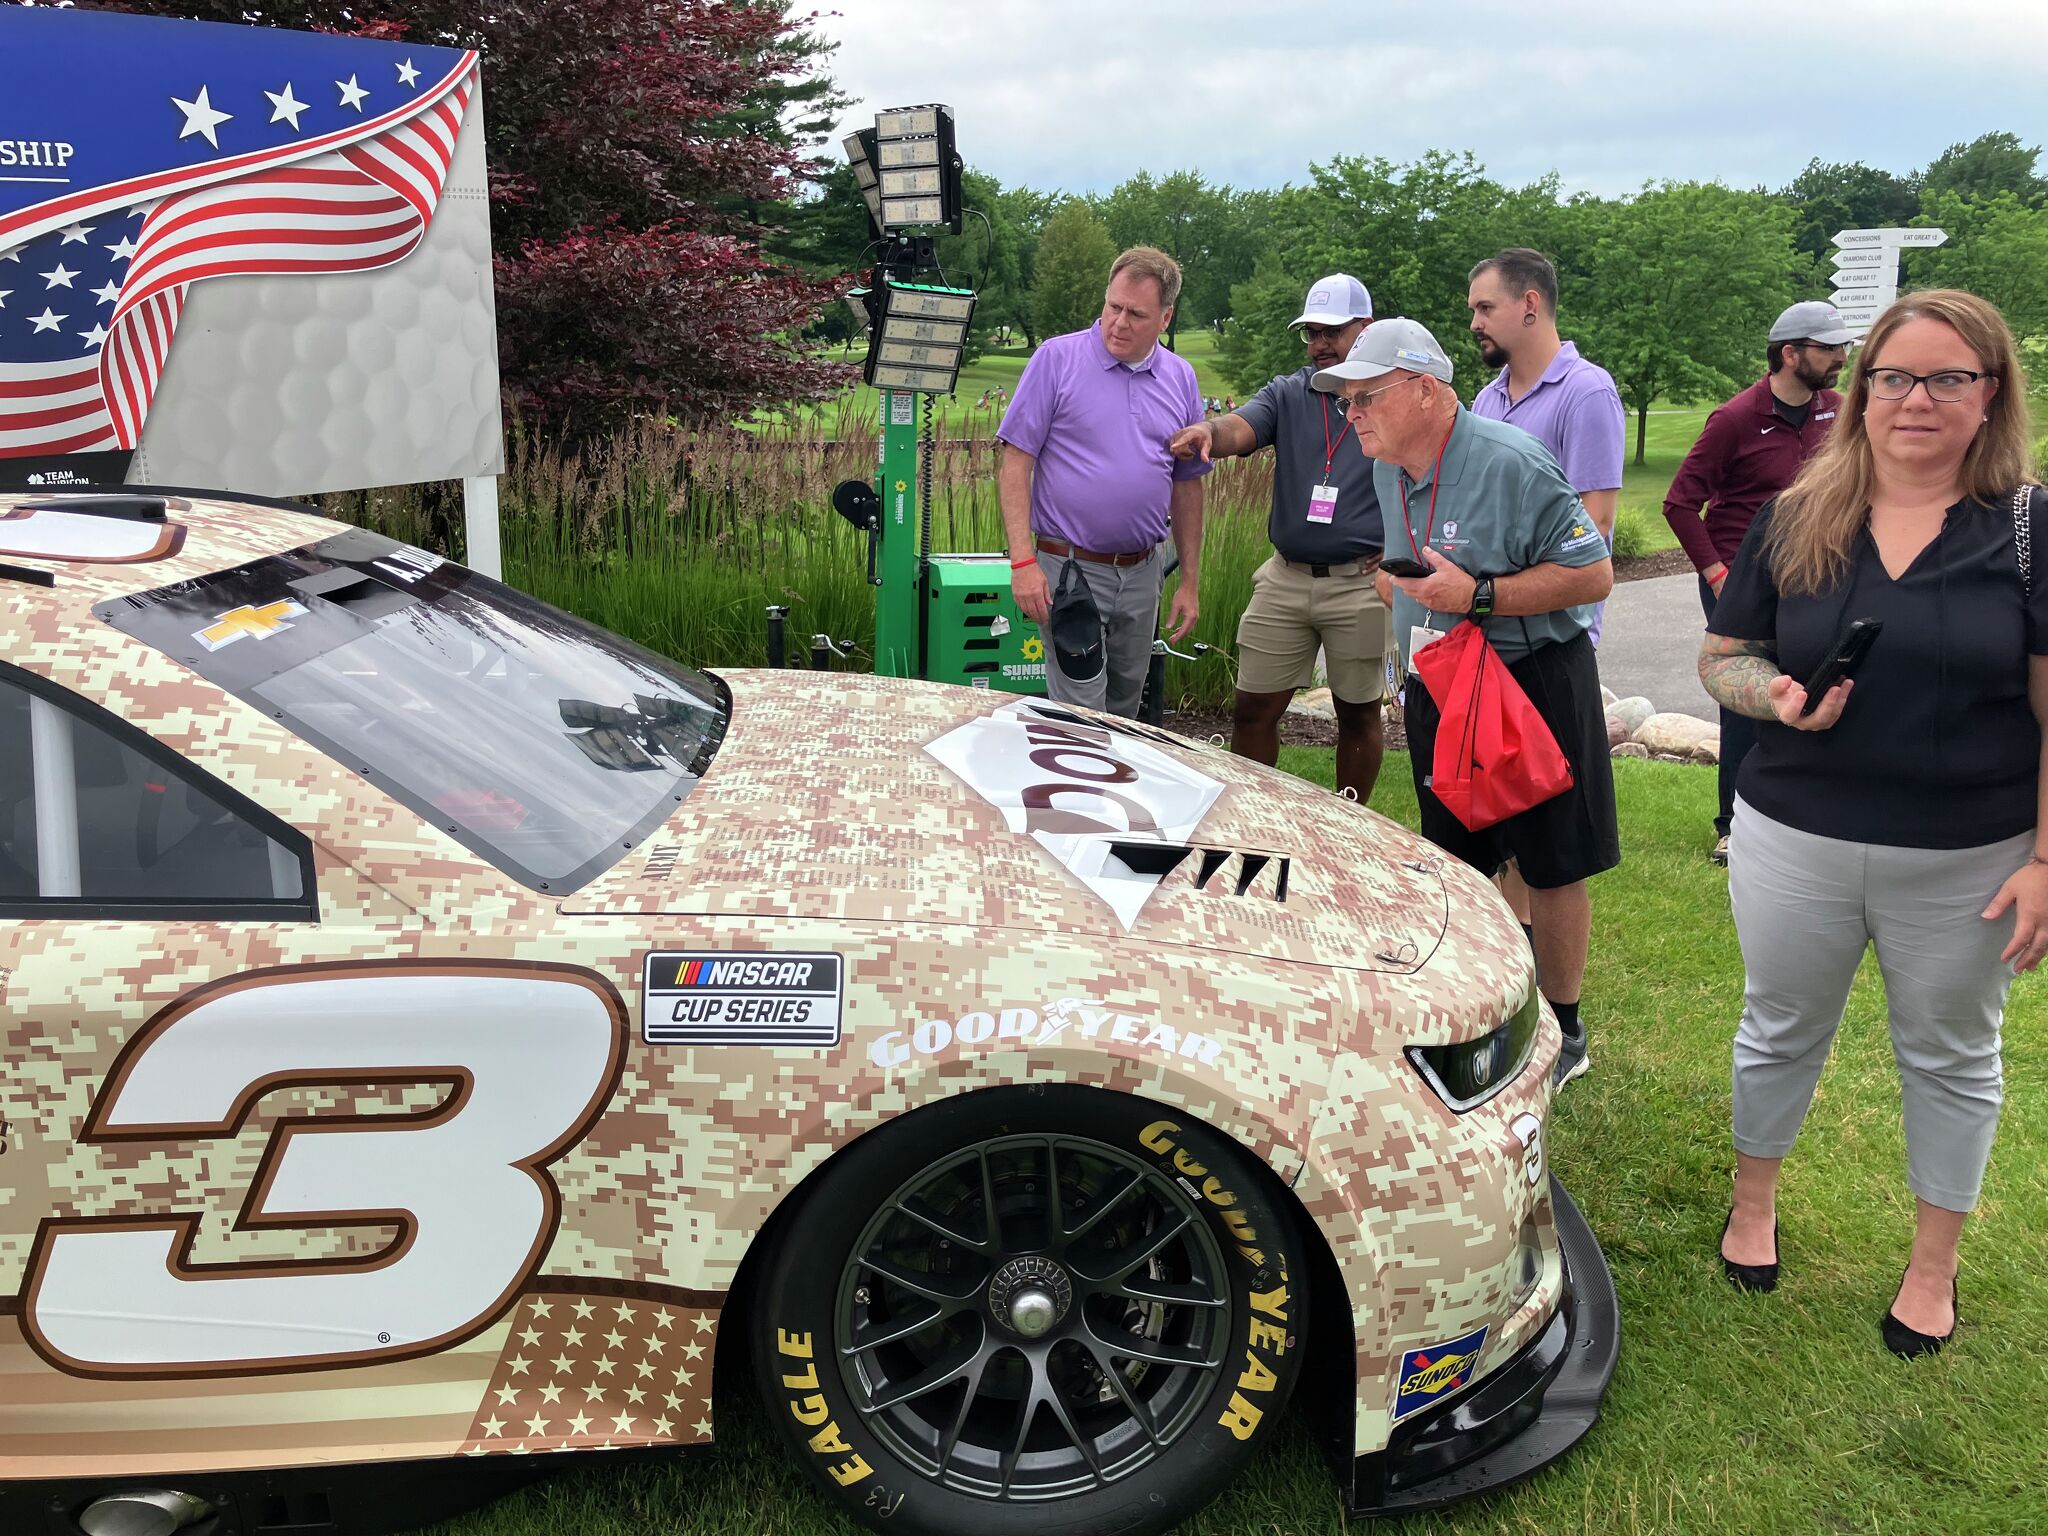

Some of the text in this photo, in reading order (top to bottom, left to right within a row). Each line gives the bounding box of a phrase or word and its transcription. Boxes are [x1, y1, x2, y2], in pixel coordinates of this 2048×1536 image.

[1843, 235, 1881, 243] CONCESSIONS
[45, 470, 74, 481] TEAM
[1002, 663, 1047, 677] SUNB
[1017, 712, 1168, 842] DOW
[640, 844, 683, 882] ARMY
[707, 960, 814, 986] NASCAR
[671, 999, 813, 1023] CUP SERIES
[1508, 1111, 1543, 1187] 3
[13, 957, 632, 1382] 3
[1401, 1351, 1476, 1395] SUNOCO
[777, 1327, 875, 1487] EAGLE
